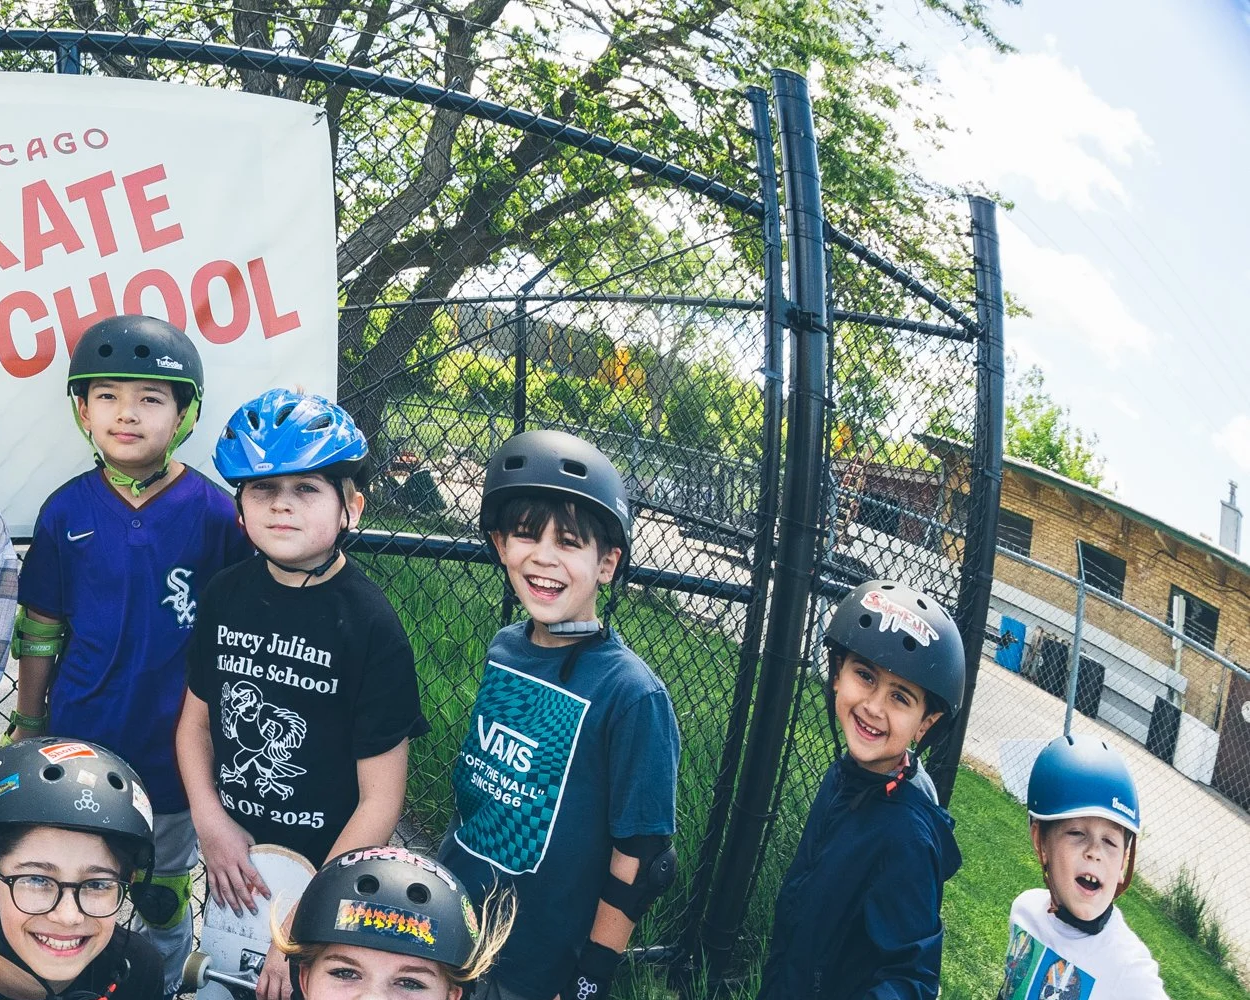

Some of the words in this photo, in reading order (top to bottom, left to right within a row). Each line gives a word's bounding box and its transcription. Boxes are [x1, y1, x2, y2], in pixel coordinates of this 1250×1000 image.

[161, 567, 197, 625] Sox
[217, 625, 264, 655] Percy
[266, 633, 332, 668] Julian
[266, 664, 338, 694] School
[478, 714, 539, 773] VANS
[471, 772, 495, 795] SINCE
[492, 788, 522, 808] 966
[484, 764, 499, 783] THE
[238, 800, 264, 818] OF
[270, 810, 325, 829] 2025
